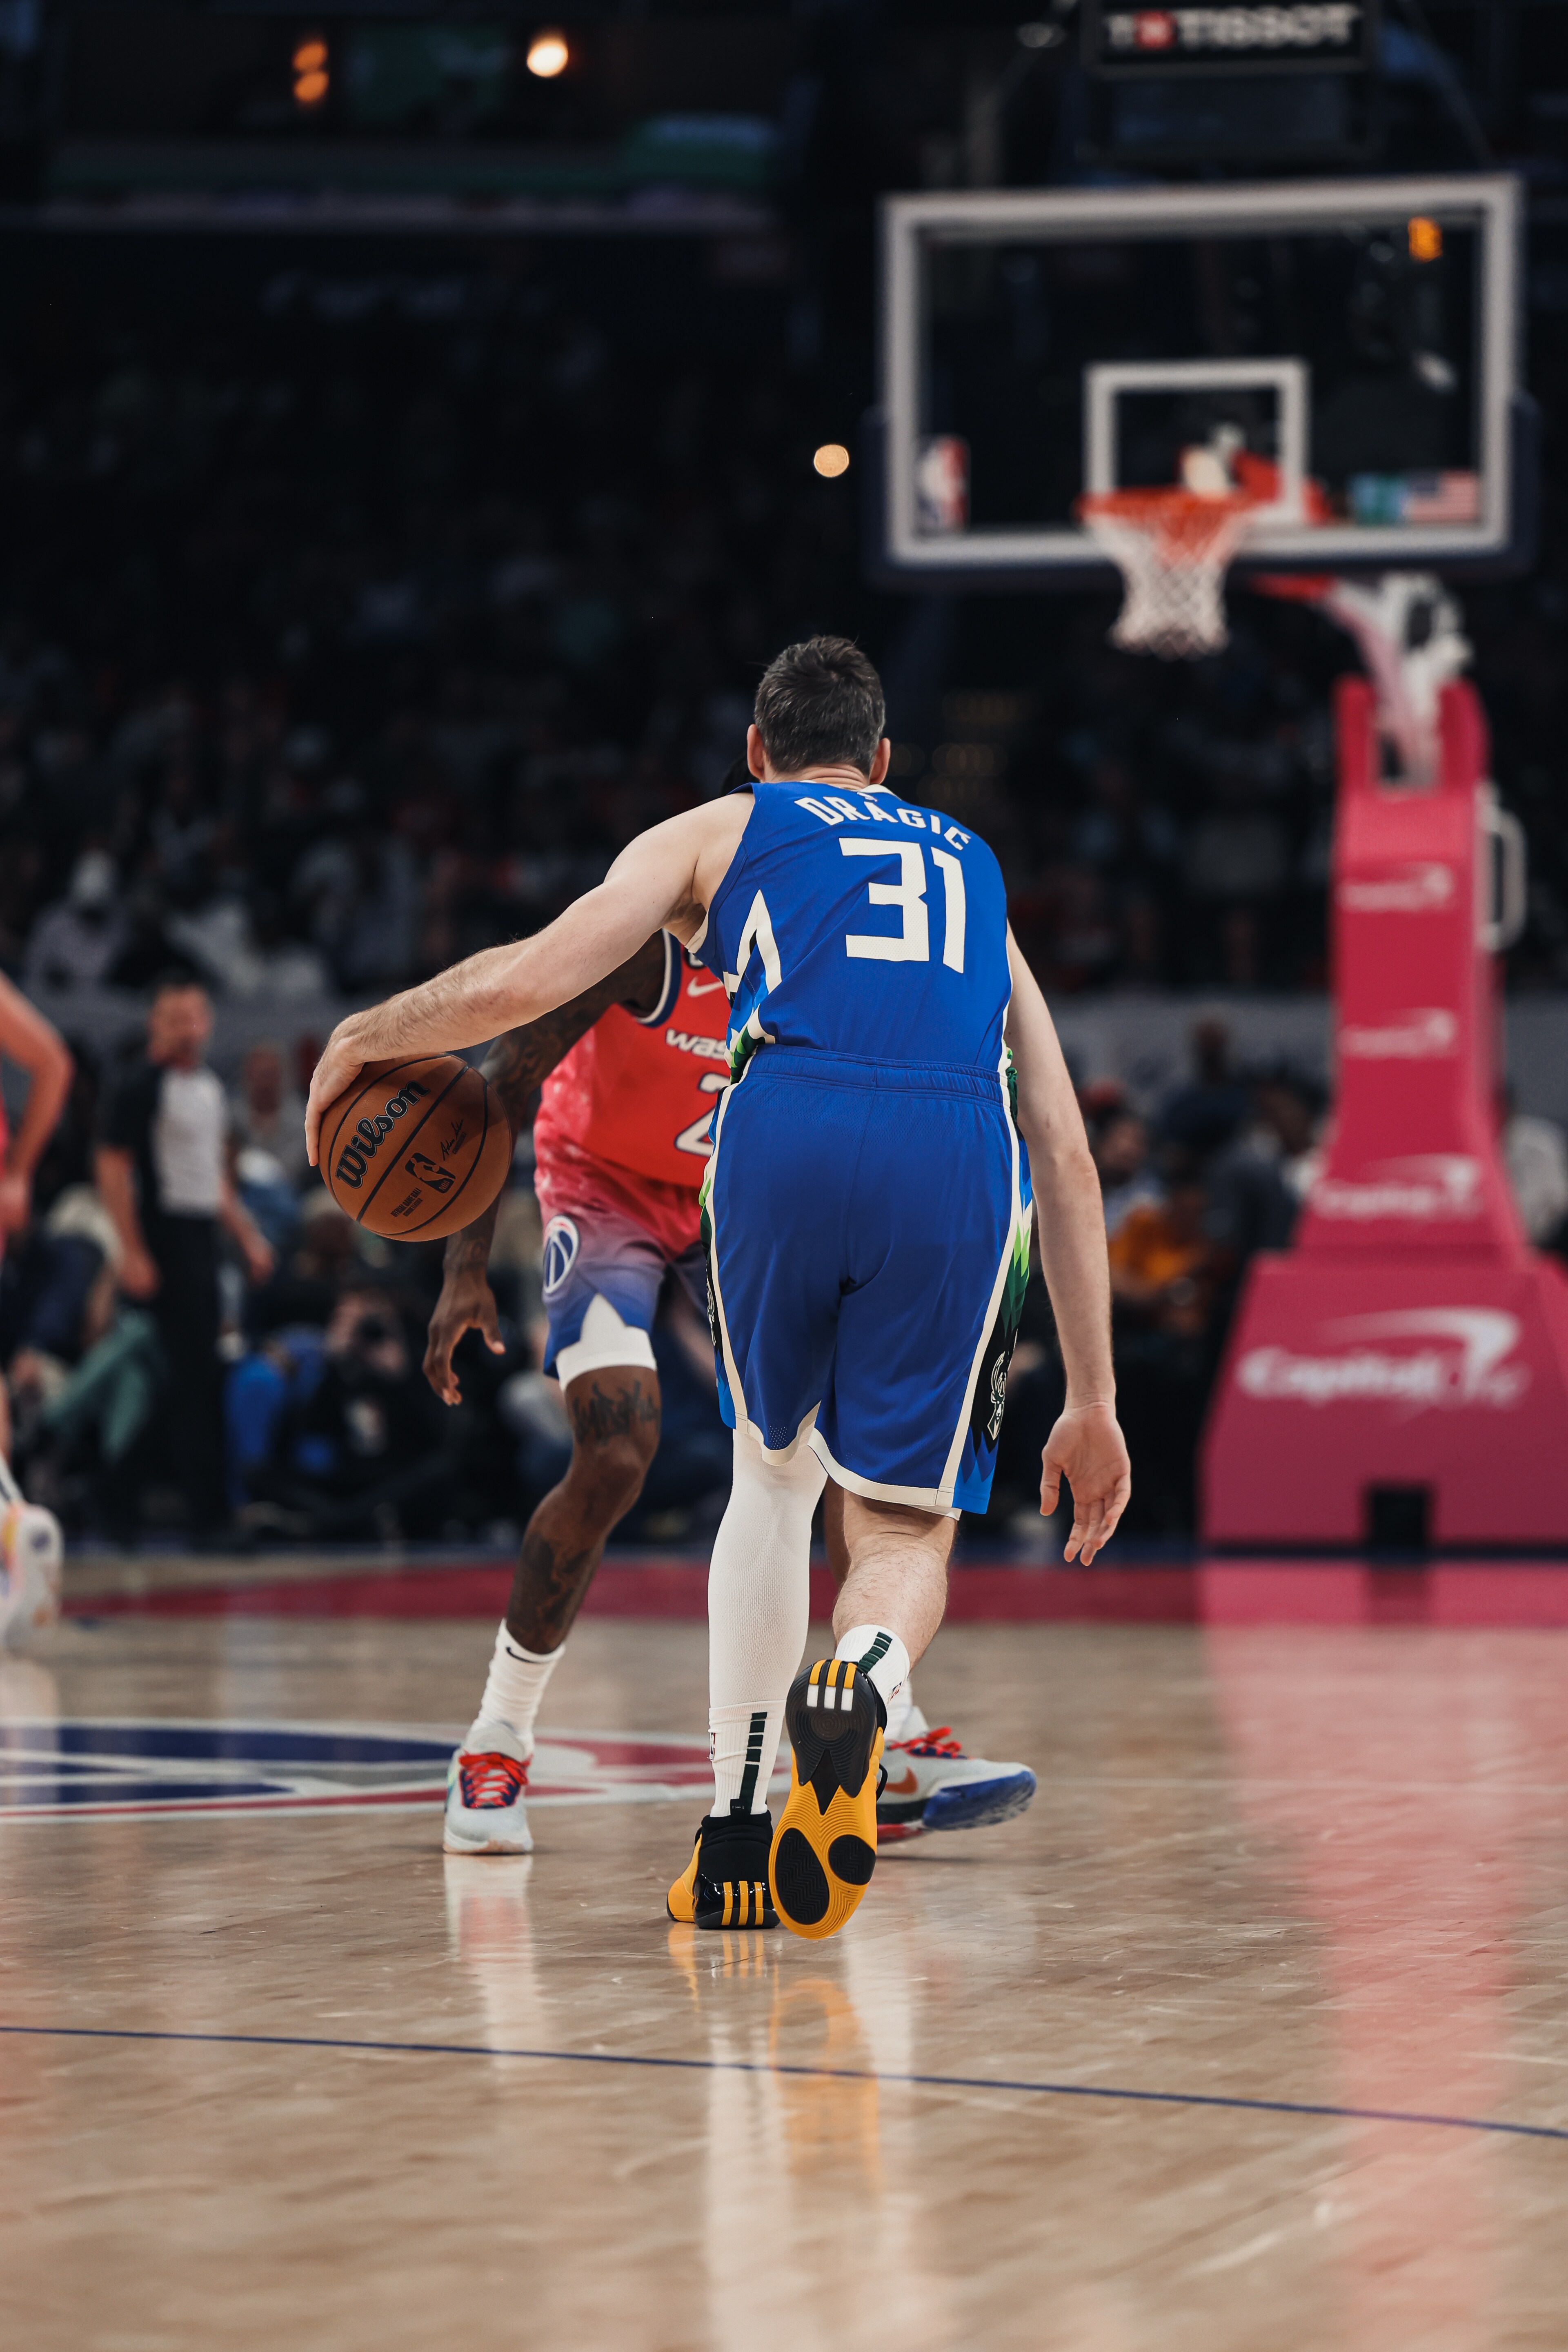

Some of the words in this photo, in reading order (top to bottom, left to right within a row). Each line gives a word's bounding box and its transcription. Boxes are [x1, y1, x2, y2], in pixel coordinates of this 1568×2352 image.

[838, 837, 966, 974] 31
[335, 1080, 431, 1189] Wilson
[402, 1194, 415, 1207] GAME
[410, 1187, 422, 1198] BALL
[438, 1179, 450, 1191] NBA
